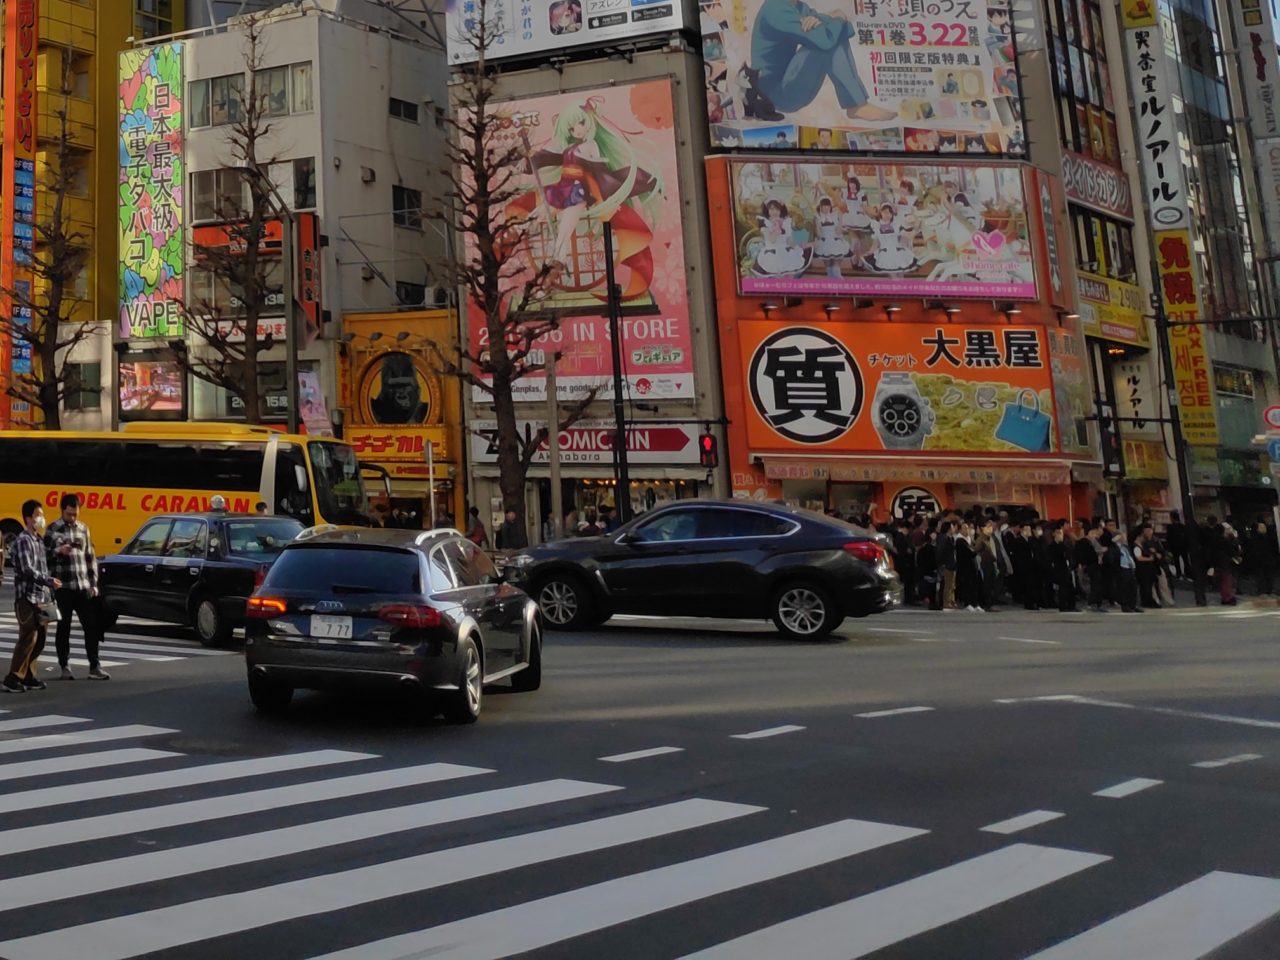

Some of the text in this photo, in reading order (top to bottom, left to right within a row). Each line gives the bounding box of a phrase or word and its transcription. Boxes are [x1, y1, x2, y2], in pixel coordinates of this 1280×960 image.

[590, 0, 622, 11] アズレン
[908, 22, 969, 47] 3.22
[152, 83, 173, 231] 日本最大級
[128, 126, 149, 262] 電子タバコ
[124, 300, 179, 328] VAPE
[573, 322, 595, 341] IN
[868, 329, 1043, 369] チケット 大黒屋
[763, 343, 856, 429] 質
[1191, 355, 1212, 408] FREE
